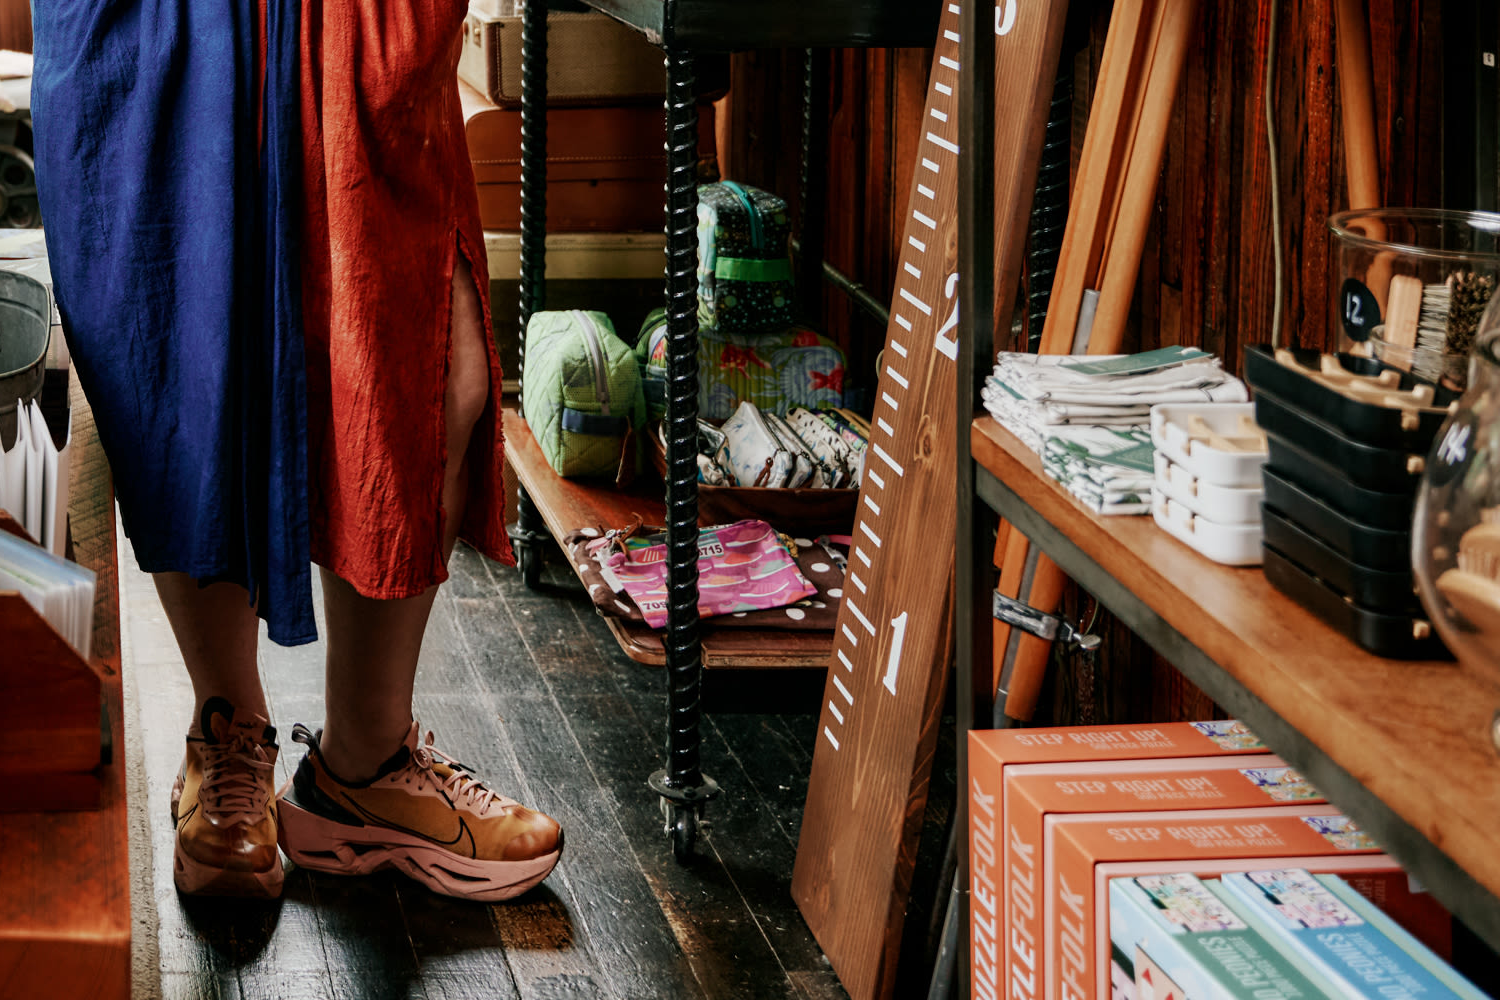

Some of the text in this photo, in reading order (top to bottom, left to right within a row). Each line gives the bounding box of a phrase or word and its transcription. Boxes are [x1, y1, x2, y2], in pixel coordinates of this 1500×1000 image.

[934, 272, 960, 361] 2
[1345, 291, 1366, 327] 12
[882, 611, 909, 695] 1
[1014, 729, 1170, 747] STEP RIGHT UP!
[1055, 777, 1219, 795] STEP RIGHT UP!
[1107, 823, 1277, 842] STEP RIGHT UP!
[972, 776, 998, 1000] UZZLEFOLK
